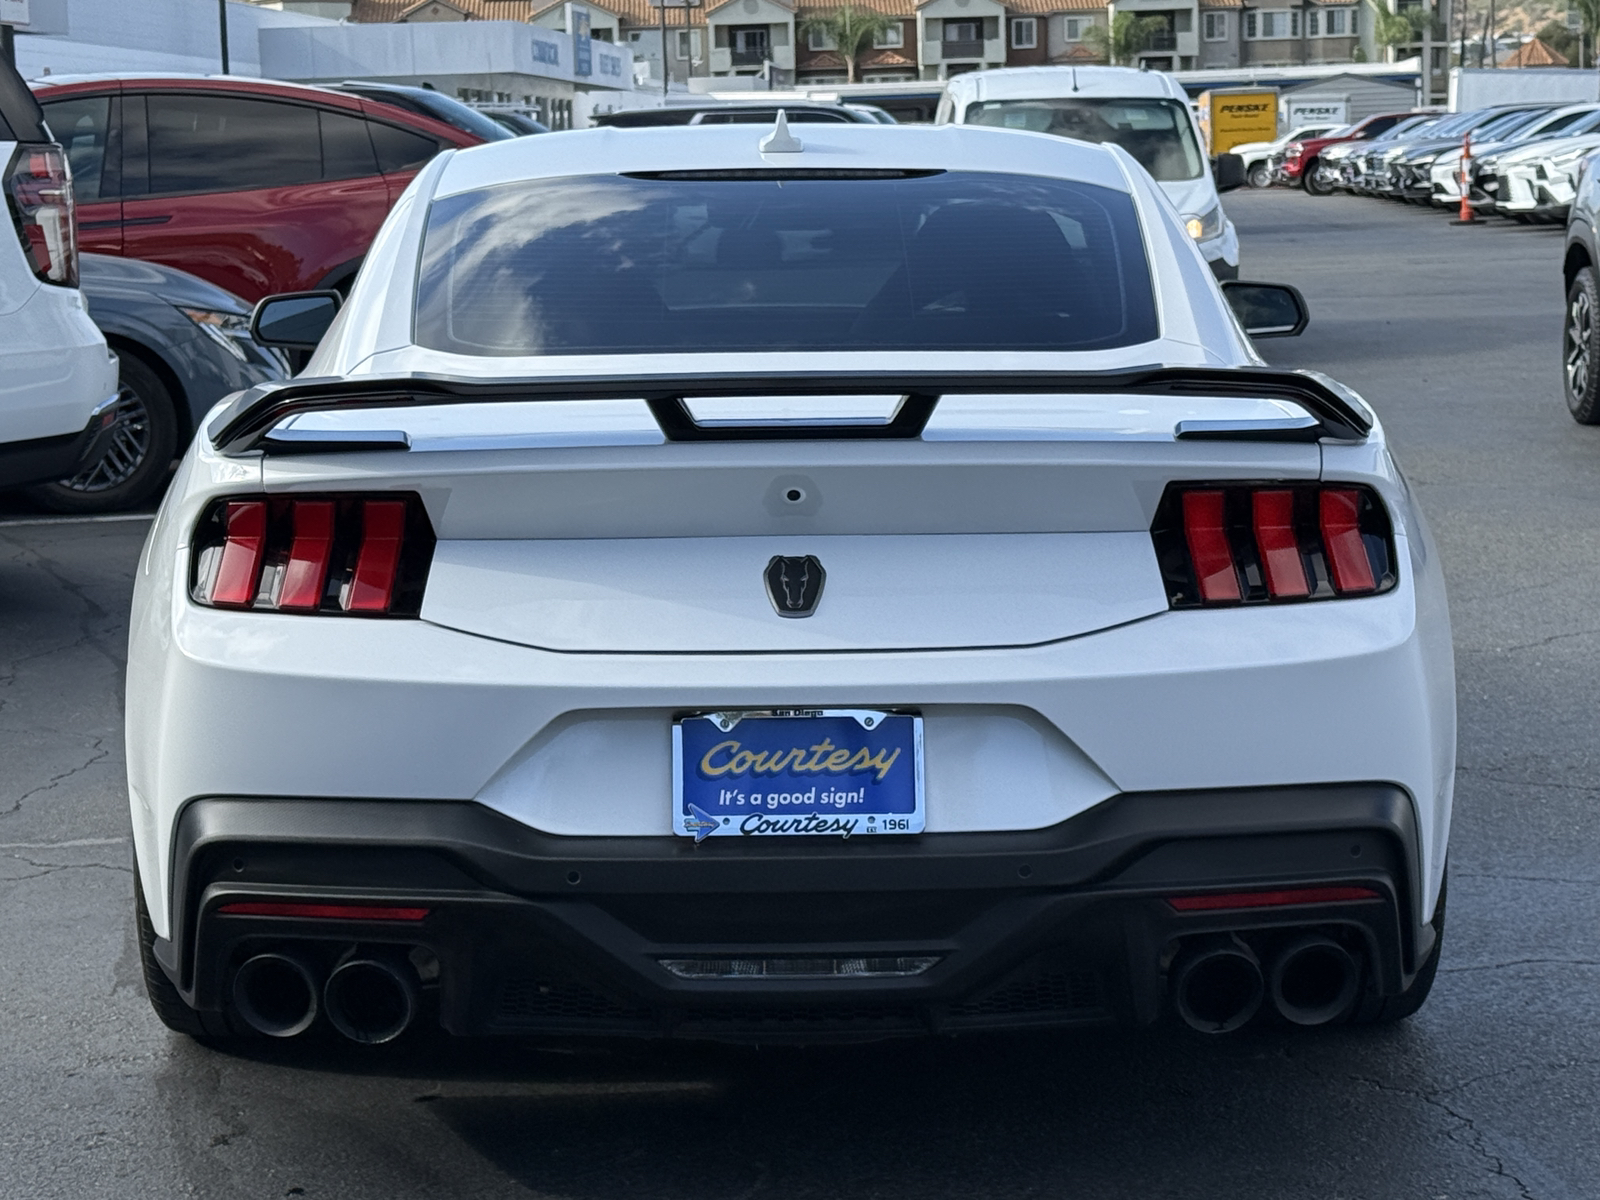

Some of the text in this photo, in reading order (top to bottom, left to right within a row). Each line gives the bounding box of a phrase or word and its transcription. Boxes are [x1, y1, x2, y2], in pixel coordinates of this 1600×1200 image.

[1220, 104, 1269, 113] PENSKE
[1294, 107, 1340, 115] PENSKE
[771, 708, 824, 718] San Diego
[700, 737, 901, 780] Courtesy
[719, 786, 865, 810] It's a good sign!
[739, 811, 910, 840] Courtesy 1961
